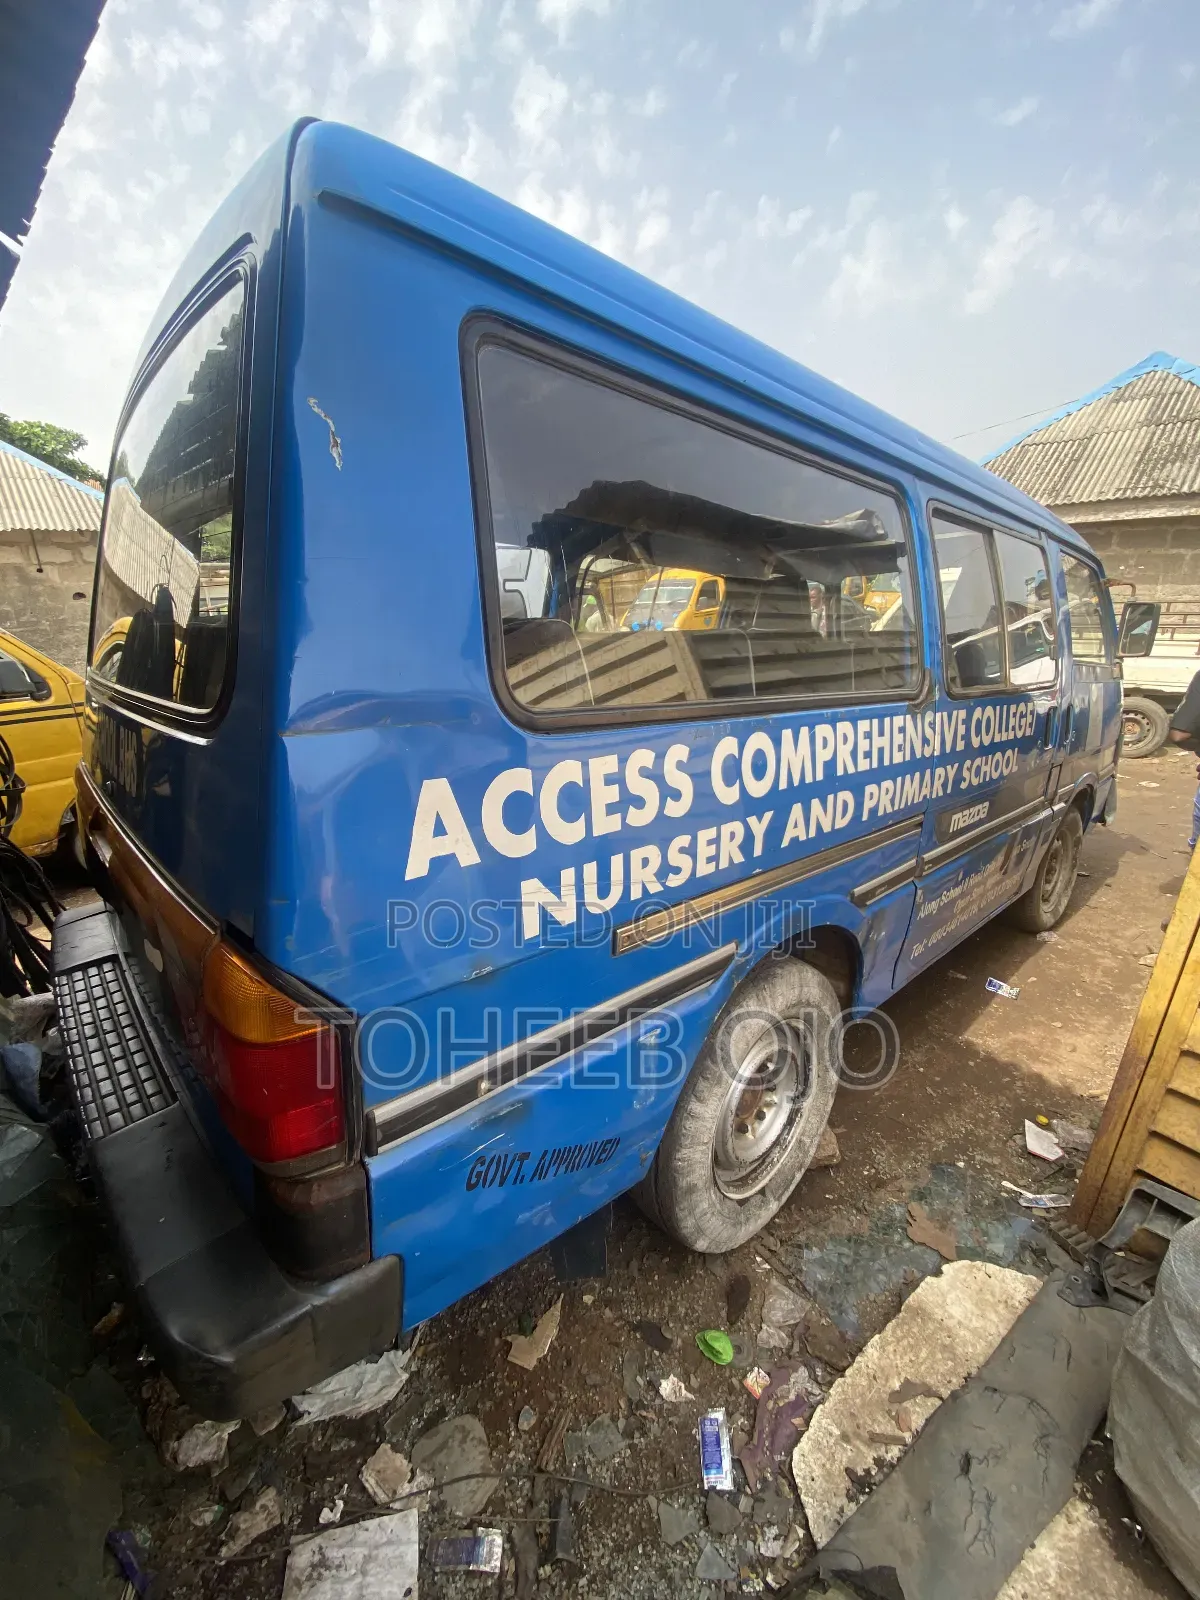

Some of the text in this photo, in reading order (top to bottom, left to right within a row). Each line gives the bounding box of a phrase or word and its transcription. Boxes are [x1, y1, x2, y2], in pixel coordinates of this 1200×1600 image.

[118, 725, 138, 798] BUS
[404, 702, 1036, 881] ACCESS COMPREHENSIVE COLLEGE
[520, 747, 1019, 940] NURSERY AND PRIMARY SCHOOL
[465, 1137, 621, 1192] GOVT. APPROVED
